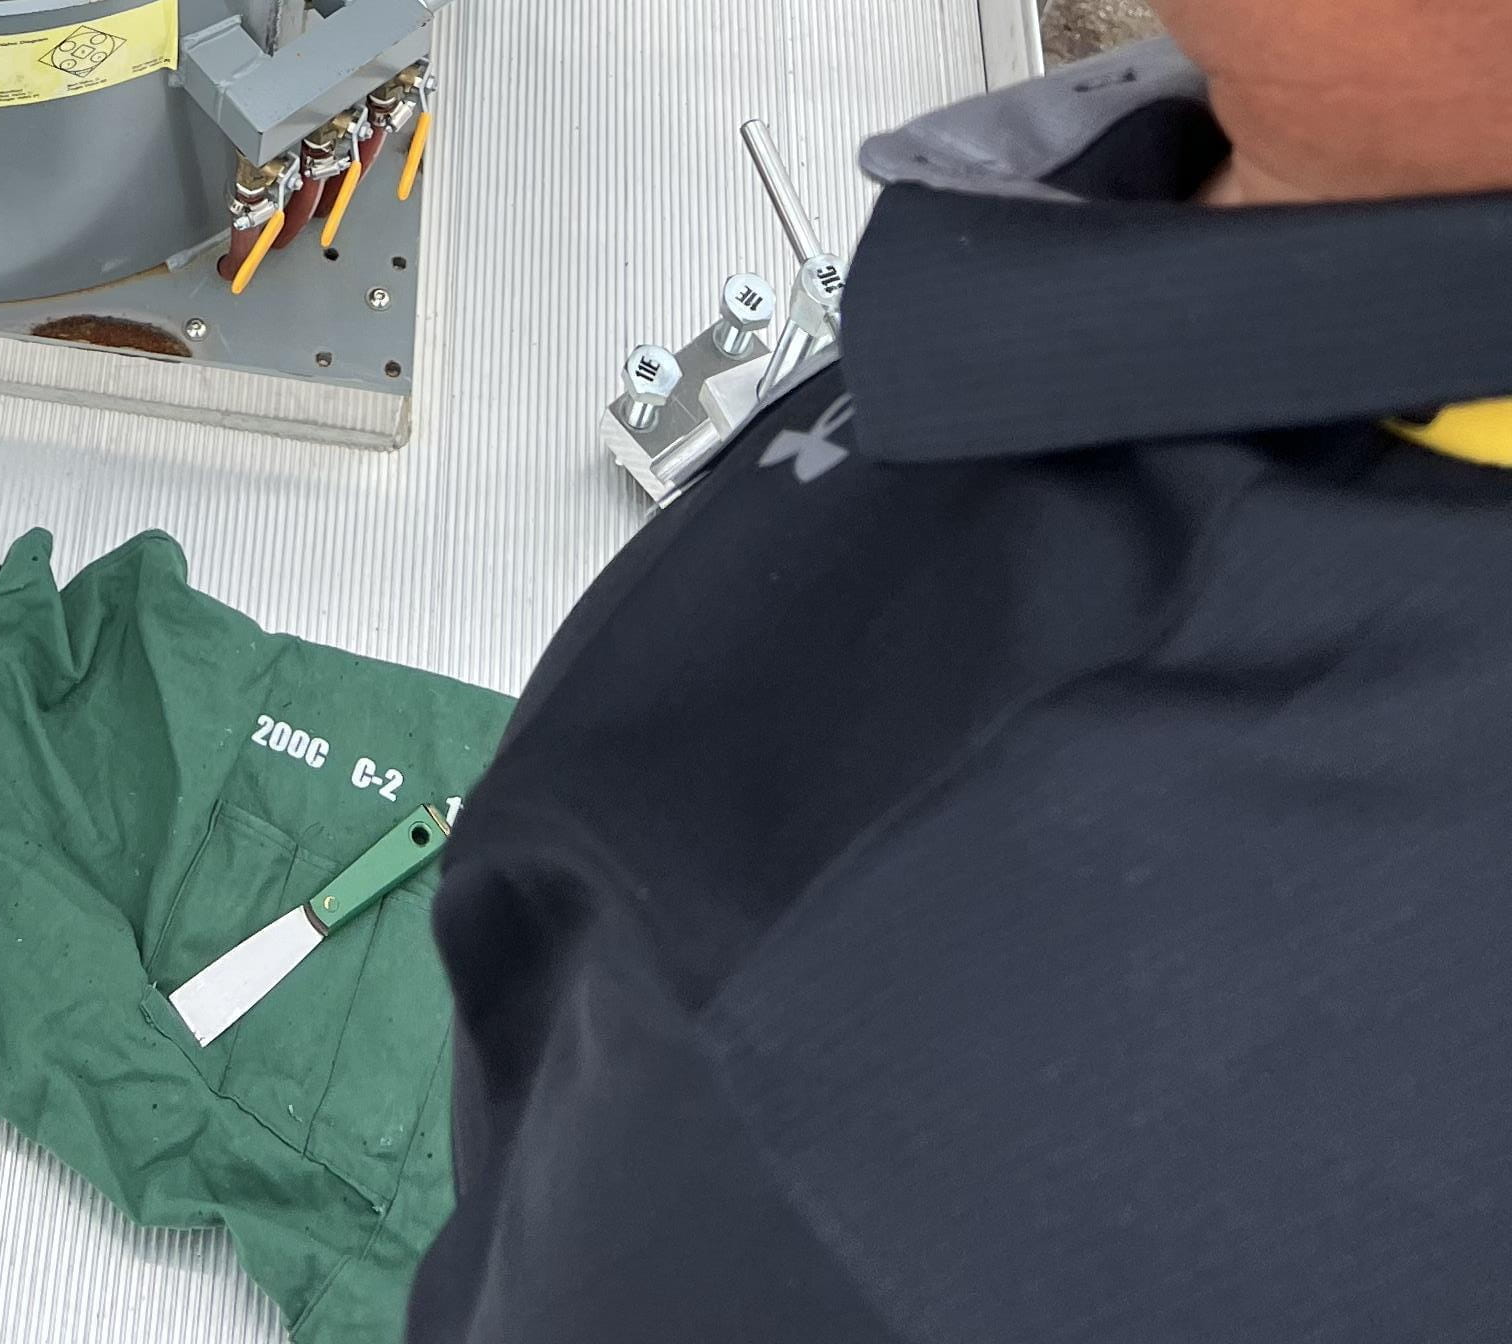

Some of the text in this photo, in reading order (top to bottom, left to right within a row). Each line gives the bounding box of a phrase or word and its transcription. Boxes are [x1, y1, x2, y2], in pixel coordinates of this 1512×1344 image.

[734, 285, 763, 311] 11E
[635, 355, 661, 382] 11E
[251, 714, 330, 769] 200C
[351, 757, 405, 802] C-2
